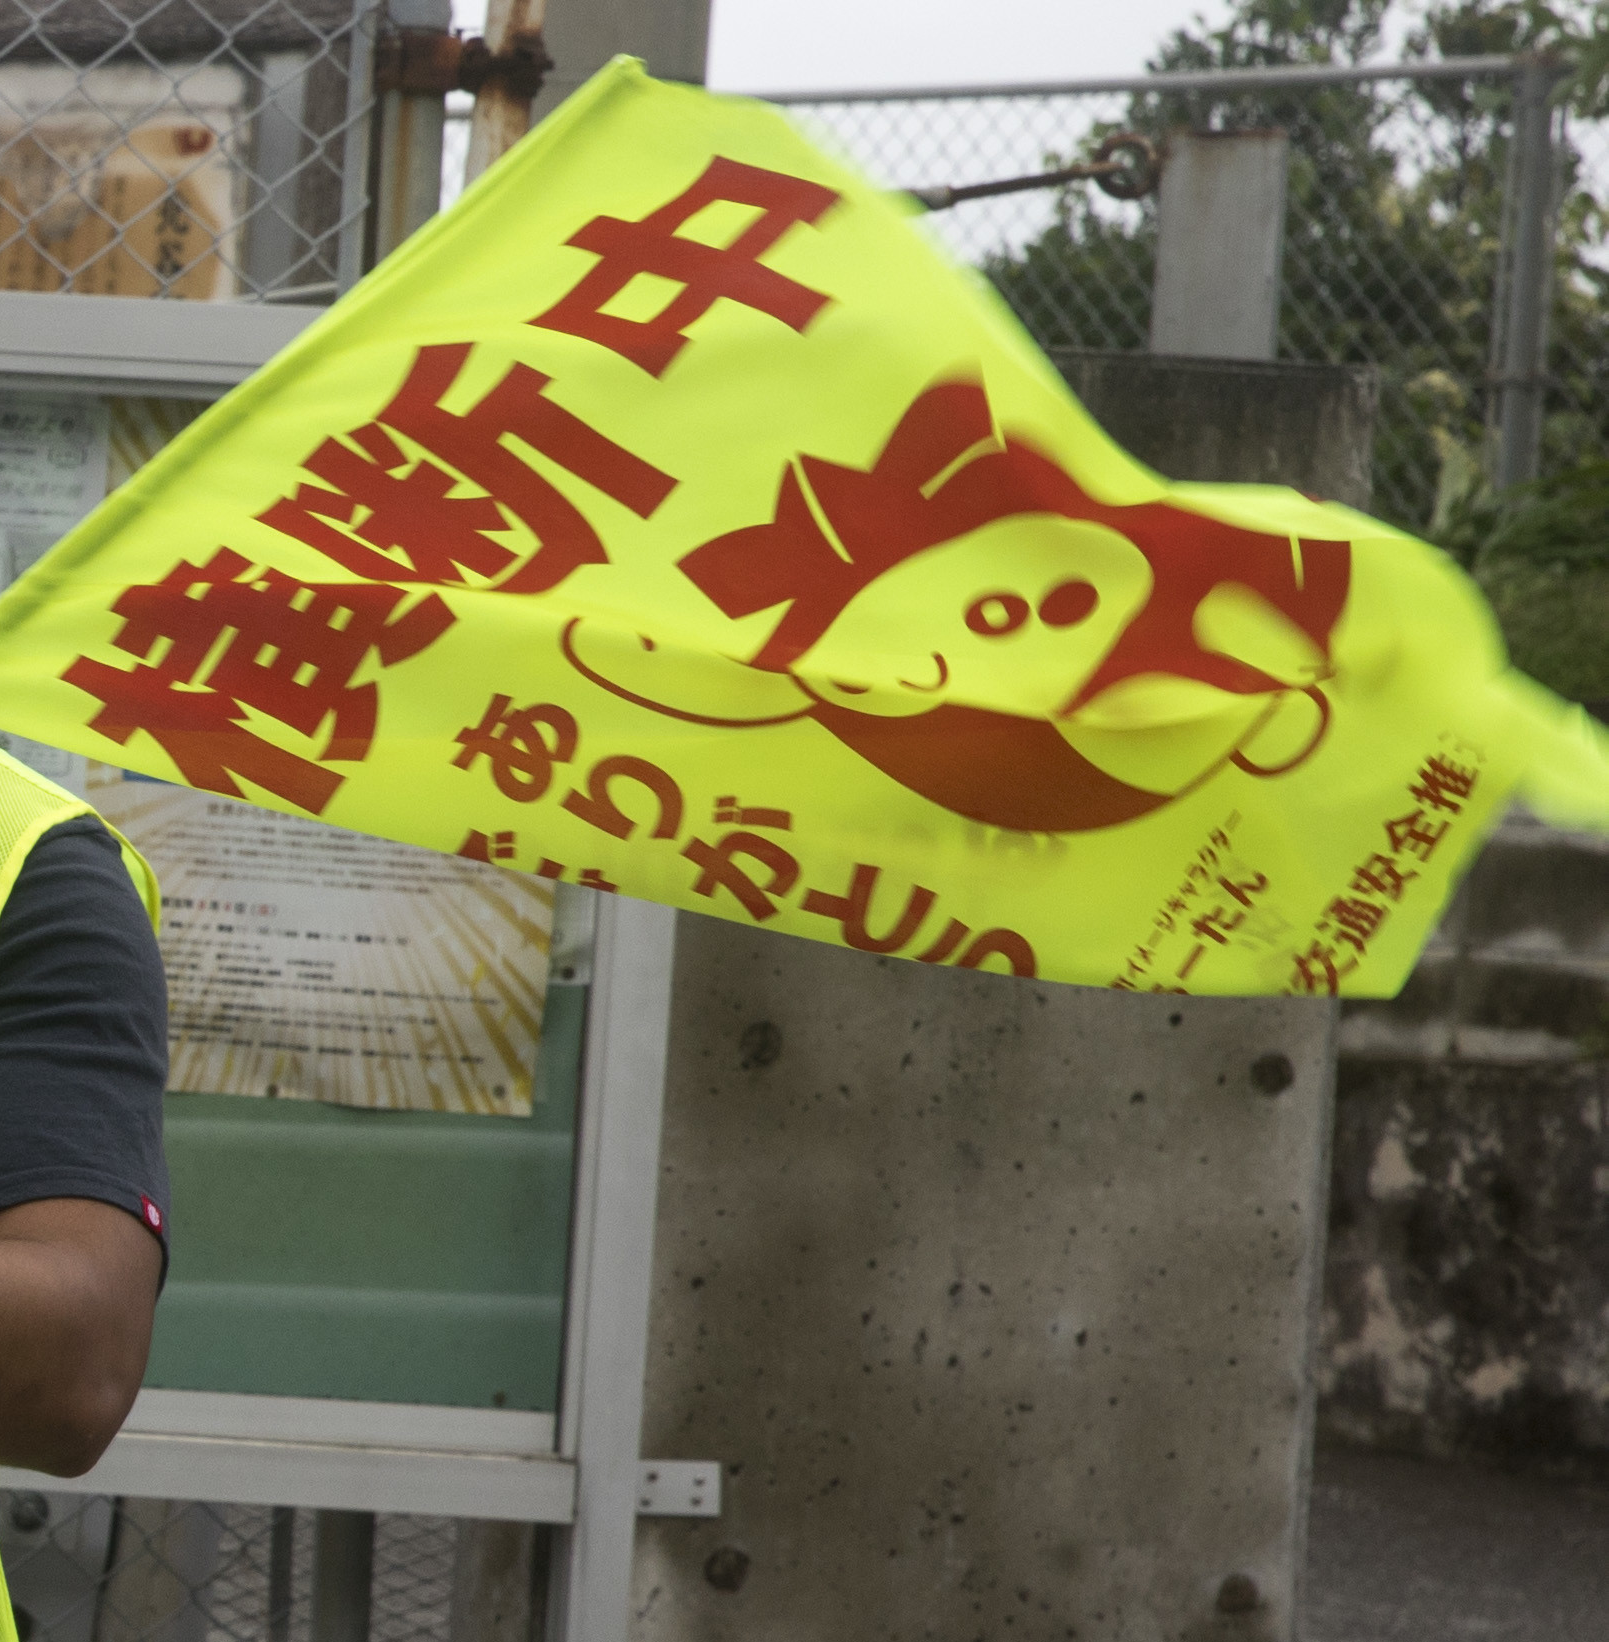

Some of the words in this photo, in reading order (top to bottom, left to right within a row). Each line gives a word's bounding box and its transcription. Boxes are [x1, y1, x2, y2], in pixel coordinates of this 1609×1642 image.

[60, 155, 843, 816] 横断中
[1148, 870, 1270, 995] ーたん
